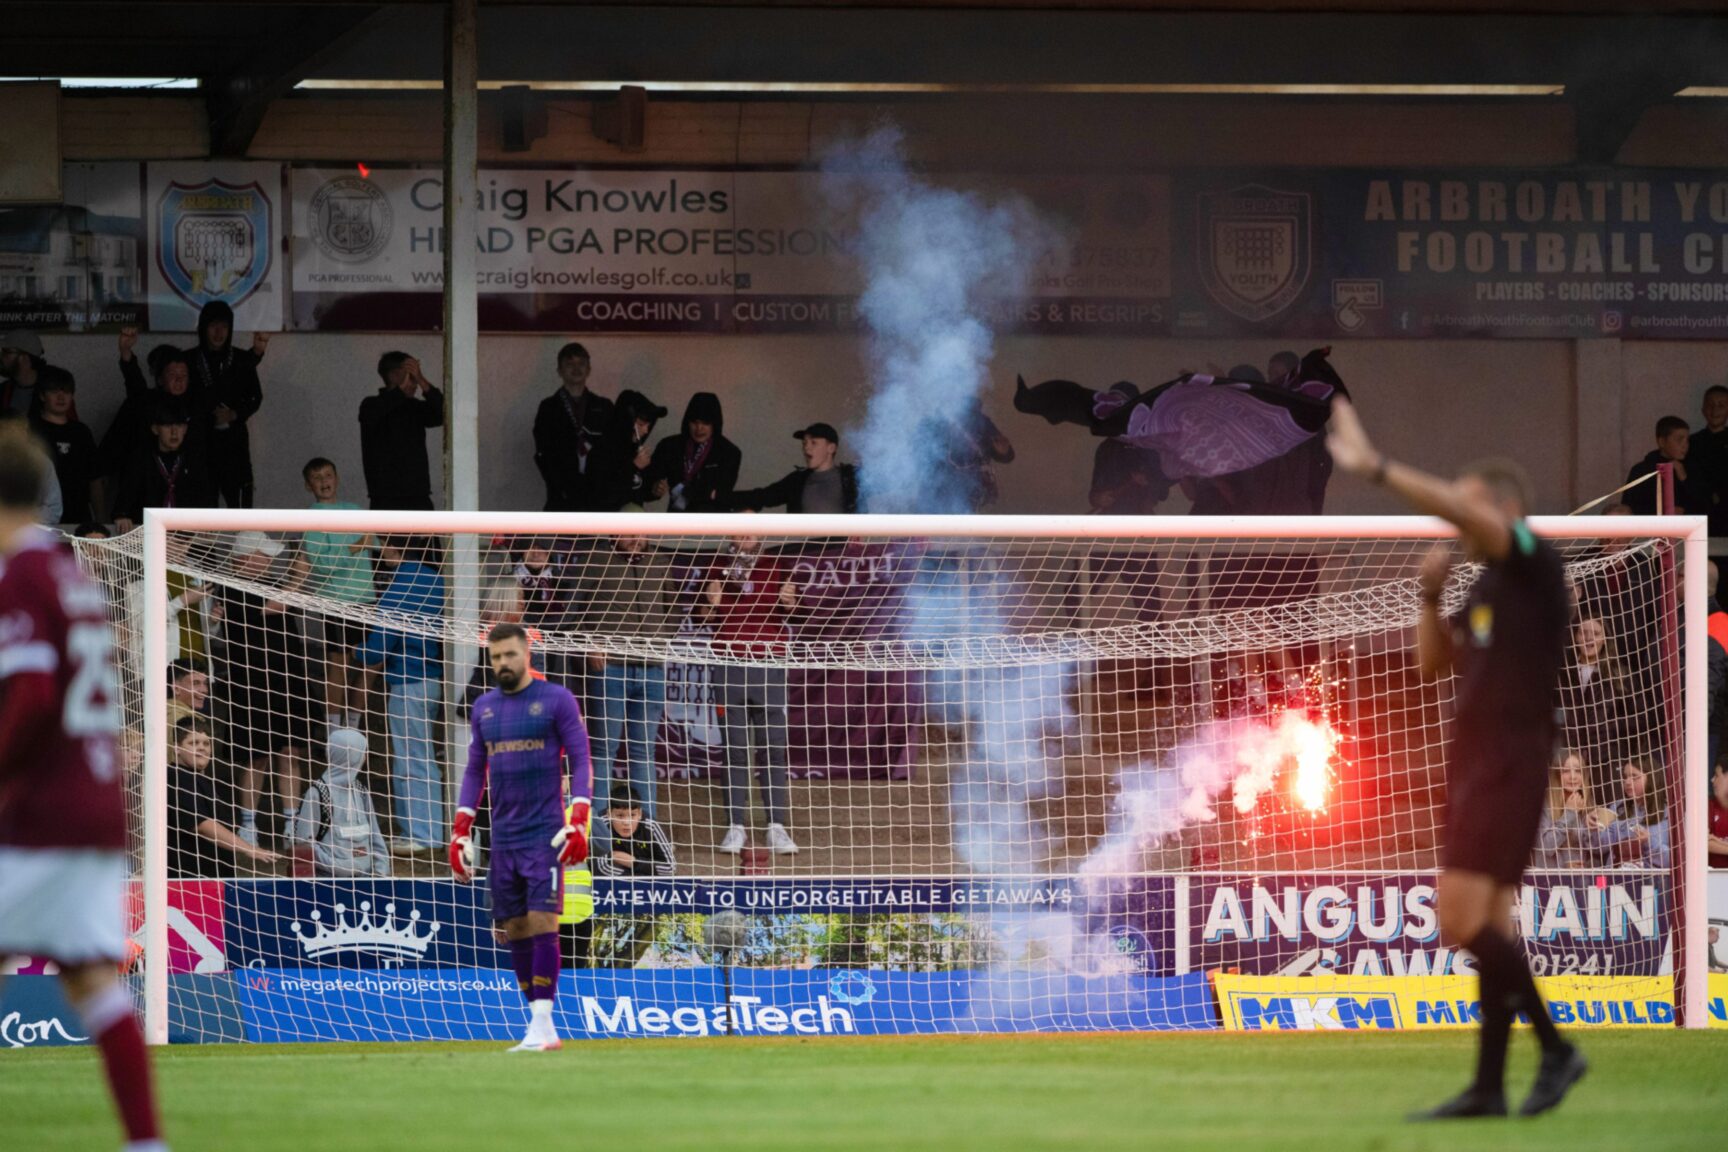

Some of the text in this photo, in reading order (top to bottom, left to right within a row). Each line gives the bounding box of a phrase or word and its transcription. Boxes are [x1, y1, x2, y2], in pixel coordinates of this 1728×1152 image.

[545, 179, 728, 213] Knowles
[1364, 180, 1651, 222] ARBROATH
[527, 228, 604, 253] PGA
[613, 228, 847, 253] PROFESSION
[1397, 231, 1660, 273] FOOTBALL
[328, 273, 394, 283] PROFESSIONAL
[1229, 273, 1278, 285] YOUTH
[1475, 282, 1545, 300] PLAYERS
[1557, 282, 1635, 300] COACHES
[25, 312, 62, 322] AFTER
[64, 312, 87, 322] THE
[577, 301, 701, 321] COACHING
[735, 302, 830, 322] CUSTOM
[1048, 303, 1064, 322] &
[1070, 303, 1164, 323] REGRIPS
[549, 866, 558, 892] 1
[590, 887, 1074, 906] GATEWAY TO UNFORGETTABLE GETAWAYS
[1202, 884, 1440, 942] ANGUS
[250, 976, 275, 991] W:
[280, 976, 513, 995] megatechprojects.co.uk
[581, 995, 854, 1037] MegaTech
[1237, 997, 1395, 1030] MKM
